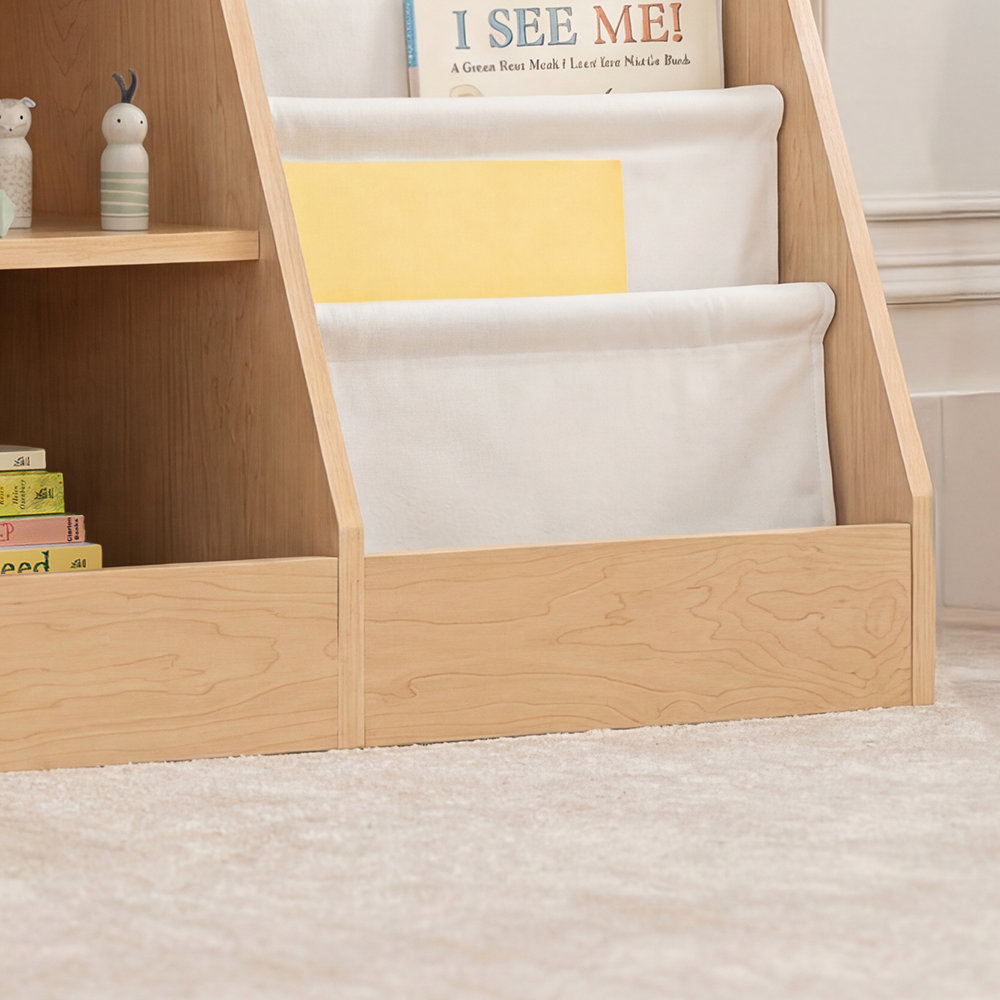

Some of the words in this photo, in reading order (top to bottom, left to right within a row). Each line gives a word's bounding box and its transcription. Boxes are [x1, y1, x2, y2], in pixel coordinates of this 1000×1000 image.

[452, 10, 471, 50] I
[488, 7, 577, 48] SEE
[593, 2, 683, 44] ME!
[451, 63, 460, 73] A
